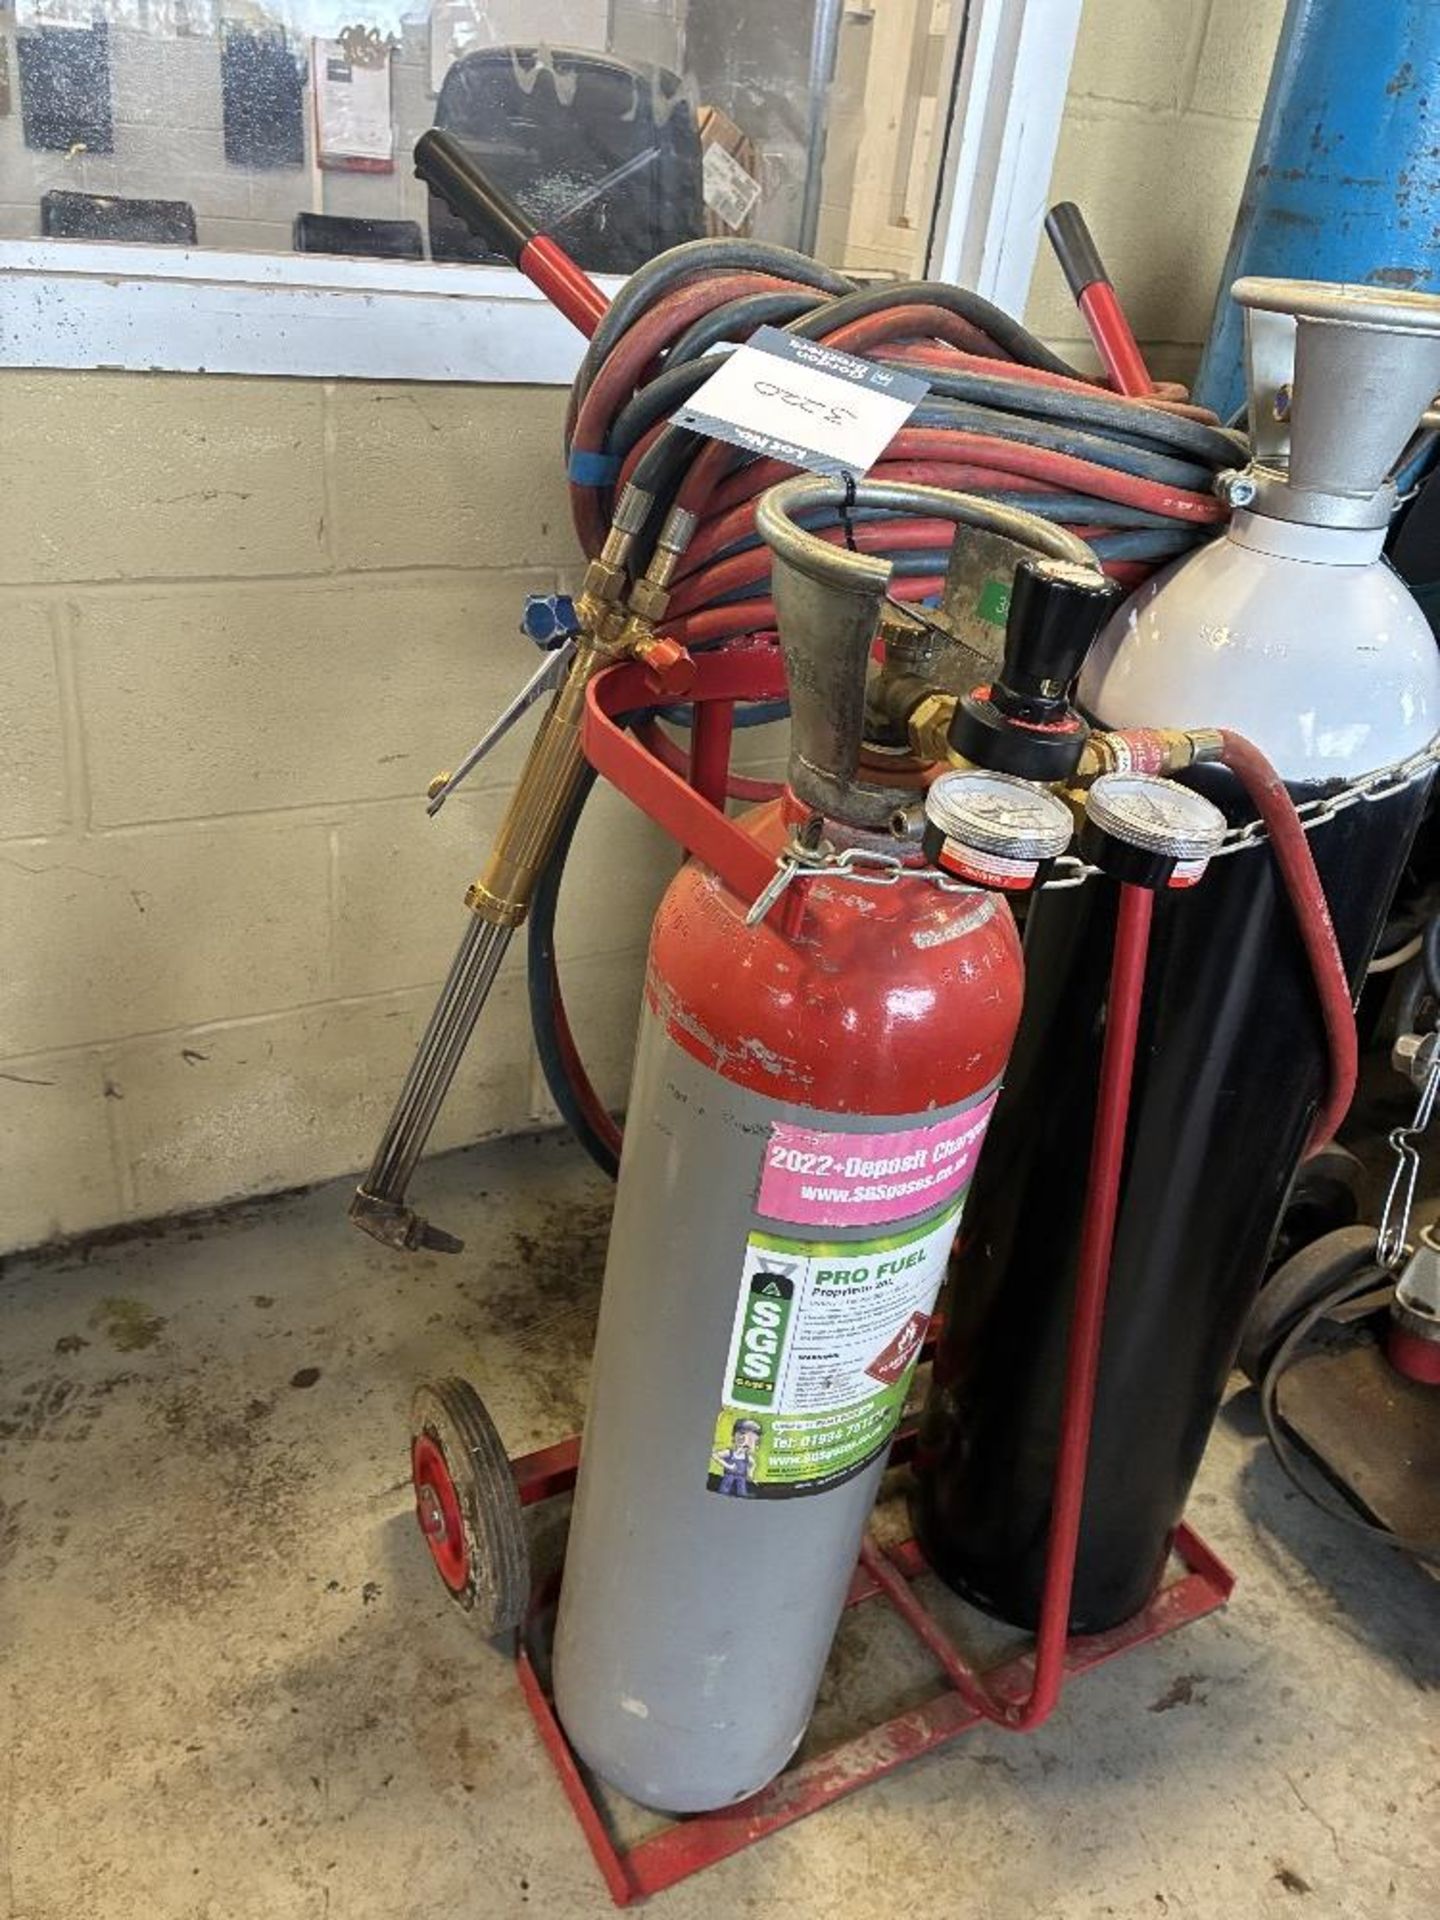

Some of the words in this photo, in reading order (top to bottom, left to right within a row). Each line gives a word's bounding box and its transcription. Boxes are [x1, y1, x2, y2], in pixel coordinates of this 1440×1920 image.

[788, 338, 870, 373] Brothers
[796, 349, 866, 380] Gordon
[774, 438, 808, 461] Lot
[814, 1267, 870, 1287] PRO
[875, 1247, 927, 1280] FUEL
[743, 1299, 783, 1379] SGS
